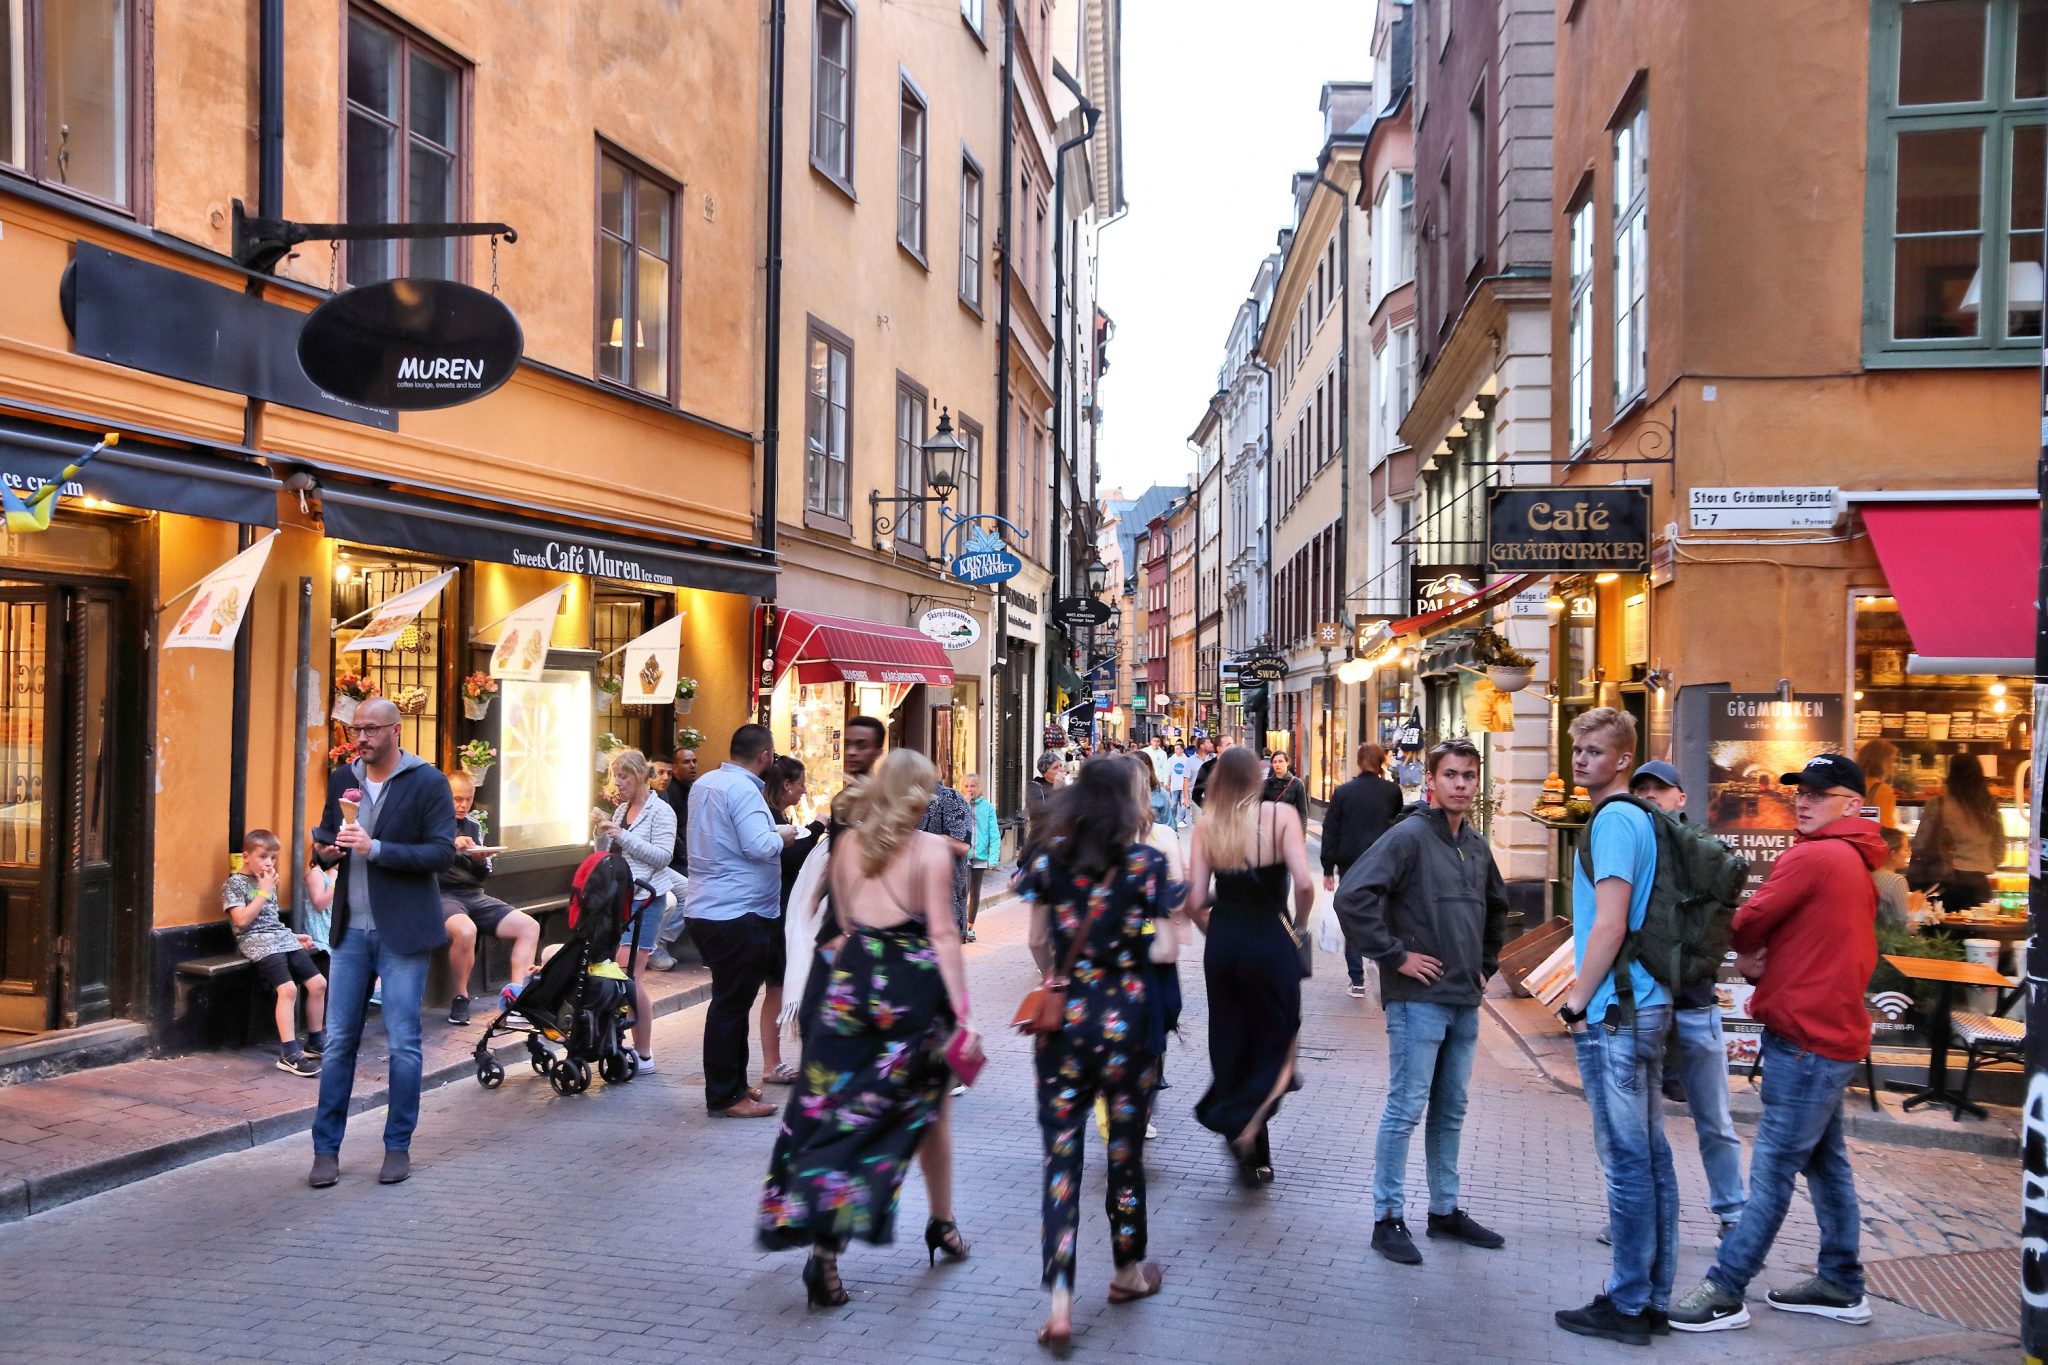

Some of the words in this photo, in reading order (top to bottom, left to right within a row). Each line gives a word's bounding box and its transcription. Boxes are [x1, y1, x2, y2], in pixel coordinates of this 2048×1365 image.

[398, 357, 484, 380] MUREN
[436, 381, 455, 389] sweets
[2, 473, 22, 488] ce
[27, 476, 84, 496] crm
[1694, 491, 1727, 503] Stora
[1733, 489, 1832, 506] Gråmunkegränd
[1528, 502, 1610, 531] Café
[1491, 538, 1645, 560] GRÅMUNKEN
[513, 548, 546, 568] Sweets
[545, 541, 584, 574] Café
[587, 548, 641, 581] Muren
[641, 569, 653, 582] Ice
[653, 573, 673, 585] cream
[959, 553, 1004, 577] KRISTALL
[970, 563, 1014, 581] RUMMET
[1420, 573, 1461, 598] The
[1516, 605, 1529, 613] 1-5
[1257, 669, 1281, 679] SWEA
[1744, 720, 1770, 730] kaffe
[1742, 834, 1785, 848] HAVE
